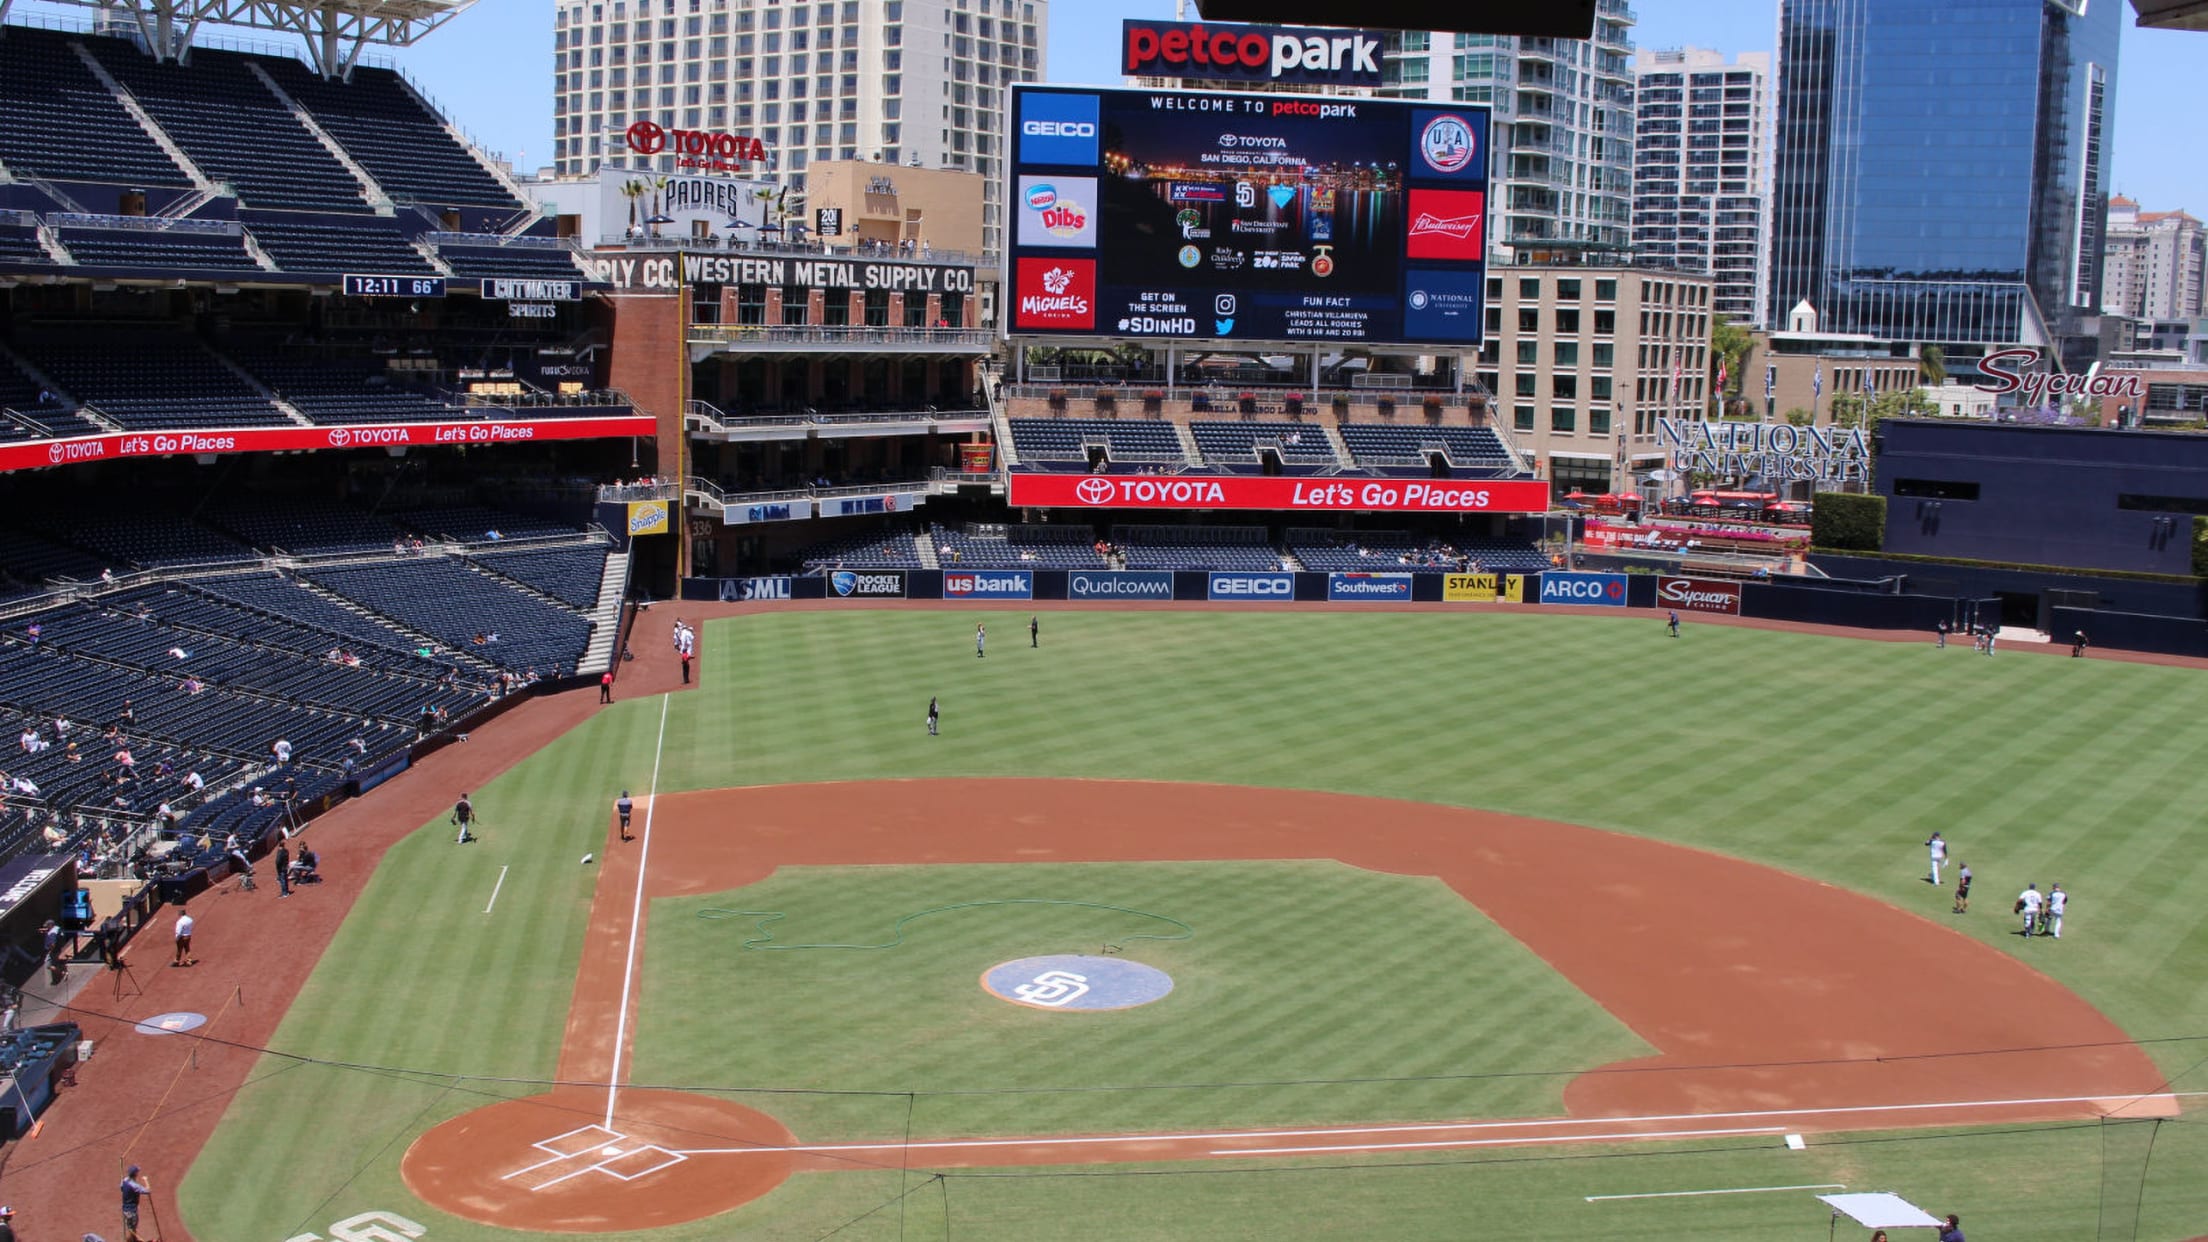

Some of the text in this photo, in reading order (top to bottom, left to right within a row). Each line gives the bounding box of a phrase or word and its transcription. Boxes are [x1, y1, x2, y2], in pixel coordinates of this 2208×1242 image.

[1151, 97, 1234, 112] WELCOME
[1244, 101, 1264, 113] TO
[1023, 121, 1095, 137] GEICO
[671, 129, 766, 161] TOYOTA
[1239, 136, 1287, 148] TOYOTA
[1201, 153, 1219, 162] SAN
[1253, 156, 1307, 165] CALIFORNIA
[1042, 206, 1085, 229] Dibs
[1416, 216, 1472, 231] Budweiser
[683, 255, 973, 292] WESTERN METAL SUPPLY CO.
[355, 278, 398, 294] 12:11
[494, 279, 572, 300] CUTWATER
[1140, 293, 1175, 302] GET ON
[1303, 297, 1351, 307] FUN FACT
[1431, 294, 1472, 302] NATIONAL
[509, 304, 556, 318] SPIRITS
[1128, 303, 1187, 313] THE SCREEN
[1285, 310, 1323, 318] CHRISTIAN
[1974, 348, 2146, 408] Sycuan
[352, 428, 409, 443] TOYOTA
[435, 425, 533, 441] Let's Go Places
[1656, 417, 1870, 458] NATIONA
[66, 442, 104, 460] TOYOTA
[120, 435, 235, 453] Let's Go Places
[1674, 450, 1870, 482] UNIVERSITY
[1120, 481, 1225, 503] TOYOTA
[1292, 483, 1489, 508] Let's Go Places
[630, 508, 666, 532] Snapple
[692, 520, 712, 536] 336
[857, 575, 900, 584] ROCKET
[1213, 578, 1291, 594] GEICO
[1335, 581, 1398, 593] Southwest
[722, 578, 789, 600] ASML
[857, 584, 900, 593] LEAGUE
[1543, 581, 1602, 597] ARCO
[1666, 580, 1732, 607] Sycuan
